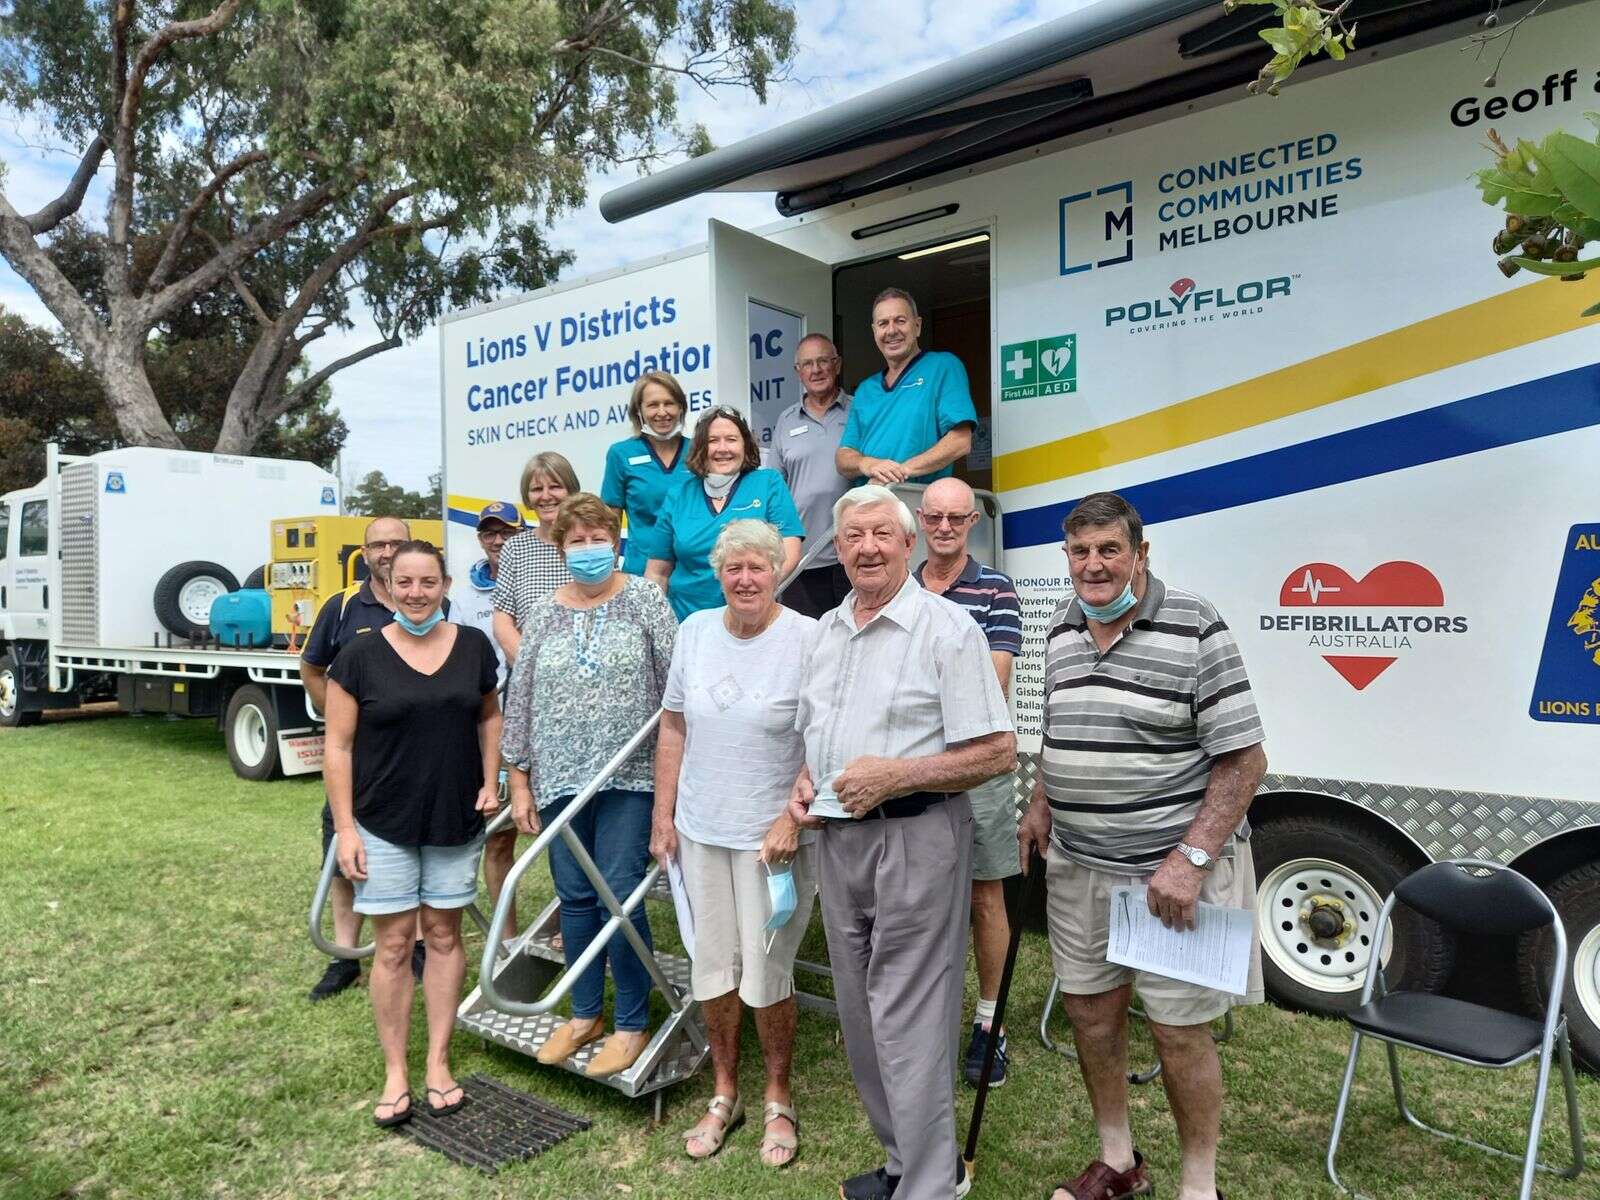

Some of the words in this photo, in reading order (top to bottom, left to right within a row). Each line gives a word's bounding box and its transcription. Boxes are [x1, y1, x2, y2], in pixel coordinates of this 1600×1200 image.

[1450, 68, 1578, 127] Geoff
[1158, 133, 1337, 193] CONNECTED
[1158, 158, 1362, 222] COMMUNITIES
[1105, 206, 1133, 241] M
[1159, 194, 1338, 251] MELBOURNE
[1105, 276, 1291, 327] POLYFLOR
[1129, 319, 1186, 334] COVERING
[1194, 314, 1214, 324] THE
[1222, 306, 1264, 319] WORLD
[466, 334, 527, 368] Lions
[534, 321, 552, 352] V
[560, 295, 676, 346] Districts
[467, 376, 548, 412] Cancer
[751, 377, 785, 402] NIT
[1004, 390, 1021, 399] First
[1022, 388, 1034, 396] Aid
[1044, 382, 1071, 395] AED
[467, 425, 501, 446] SKIN
[505, 415, 558, 440] CHECK
[563, 409, 600, 431] AND
[1575, 534, 1600, 550] AU
[1015, 577, 1060, 587] HONOUR
[1020, 610, 1052, 619] tratfor
[1023, 624, 1048, 633] arysv
[1260, 615, 1468, 633] DEFIBRILLATORS
[1308, 634, 1412, 649] AUSTRALIA
[1021, 649, 1045, 659] aylor
[1015, 661, 1042, 671] Lions
[1016, 674, 1045, 684] Echuc
[1016, 687, 1045, 697] Gisbo
[1016, 700, 1044, 710] Ballar
[1539, 700, 1590, 716] LIONS
[1016, 713, 1042, 723] Hami
[1017, 726, 1043, 735] Ende
